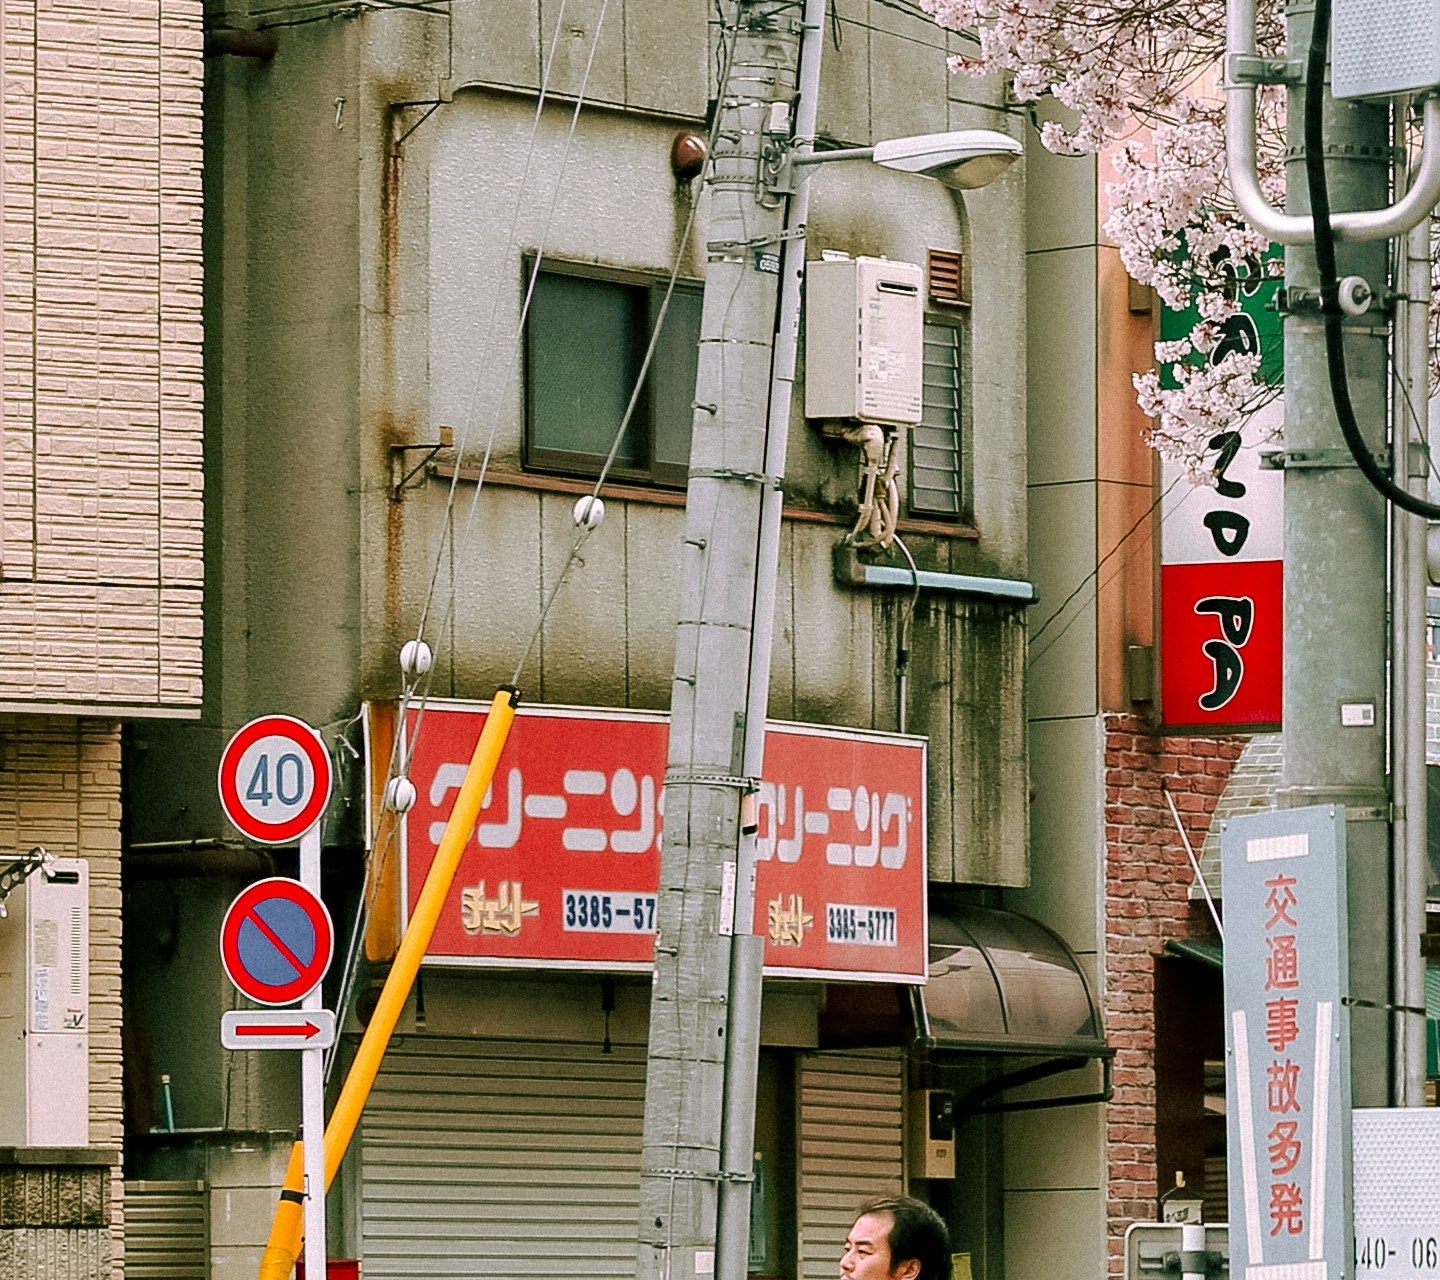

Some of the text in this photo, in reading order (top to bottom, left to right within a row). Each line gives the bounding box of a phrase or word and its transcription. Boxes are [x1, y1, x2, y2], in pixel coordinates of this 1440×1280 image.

[1194, 246, 1265, 712] GRND PA
[246, 753, 304, 806] 40
[429, 762, 664, 854] クリーニン
[755, 780, 912, 870] クリーニング
[461, 879, 540, 937] チェリー
[767, 892, 813, 946] チェリー
[828, 906, 897, 944] 3385-5777
[1264, 873, 1303, 1237] 交通事故多発
